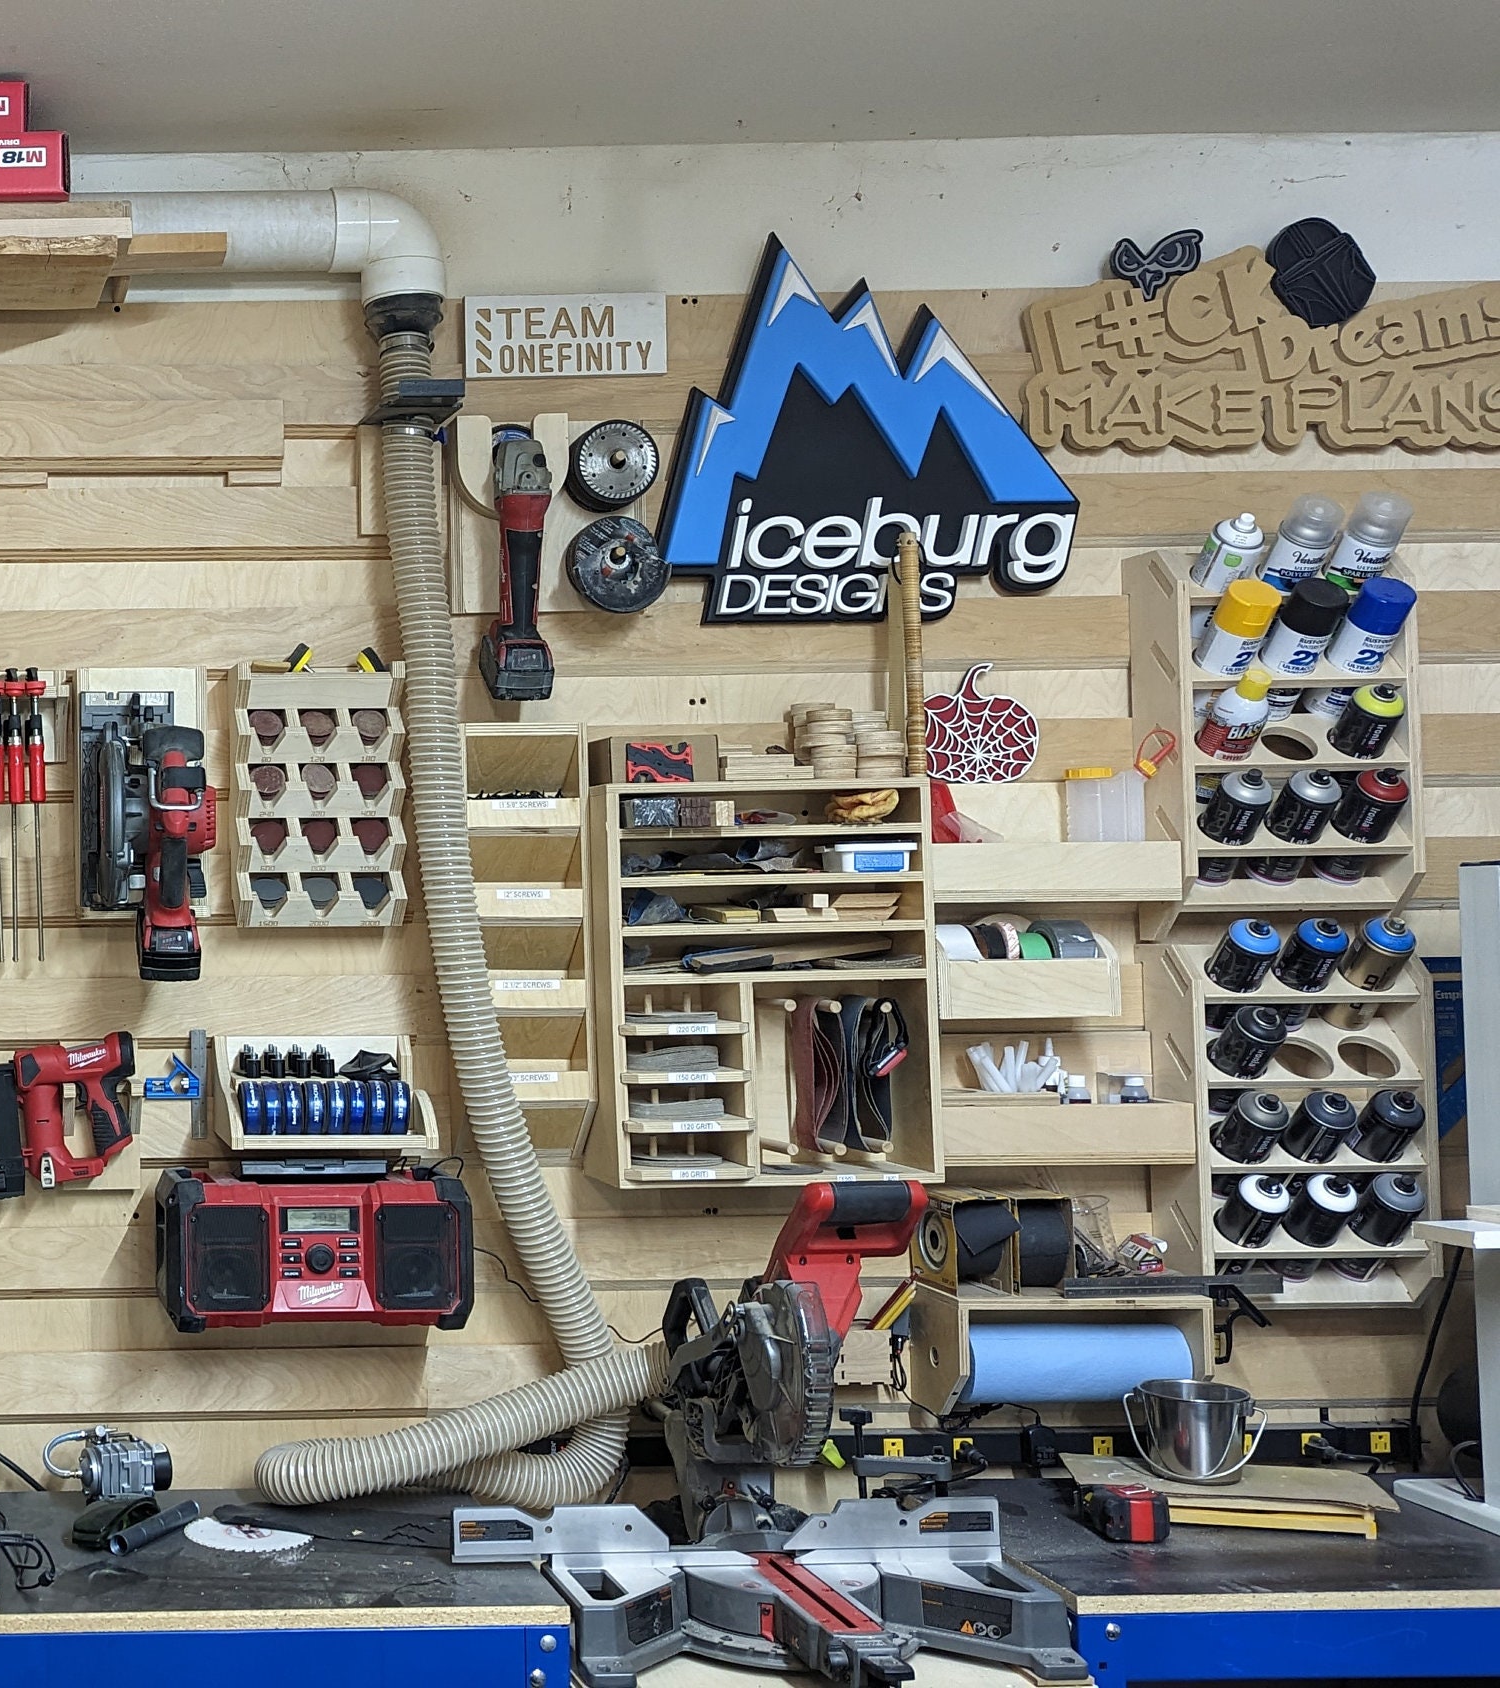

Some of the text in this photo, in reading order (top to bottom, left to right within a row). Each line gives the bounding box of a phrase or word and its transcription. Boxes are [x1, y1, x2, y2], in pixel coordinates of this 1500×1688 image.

[1, 150, 43, 165] M18
[495, 305, 615, 341] TEAM
[498, 340, 653, 374] ONEFINITY
[1043, 379, 1262, 438] MAKE
[725, 496, 1077, 585] iceburg
[715, 572, 957, 615] DESIGS
[513, 889, 544, 898] SCREWS)
[691, 1025, 708, 1033] GRIT)
[67, 1047, 106, 1067] Milwaukee
[520, 1073, 551, 1082] SCREWS)
[691, 1073, 708, 1081] GRIT)
[312, 1084, 320, 1122] ROCKLER
[695, 1121, 713, 1130] GRIT)
[690, 1170, 709, 1179] GRIT)
[297, 1281, 345, 1302] Milwaukee
